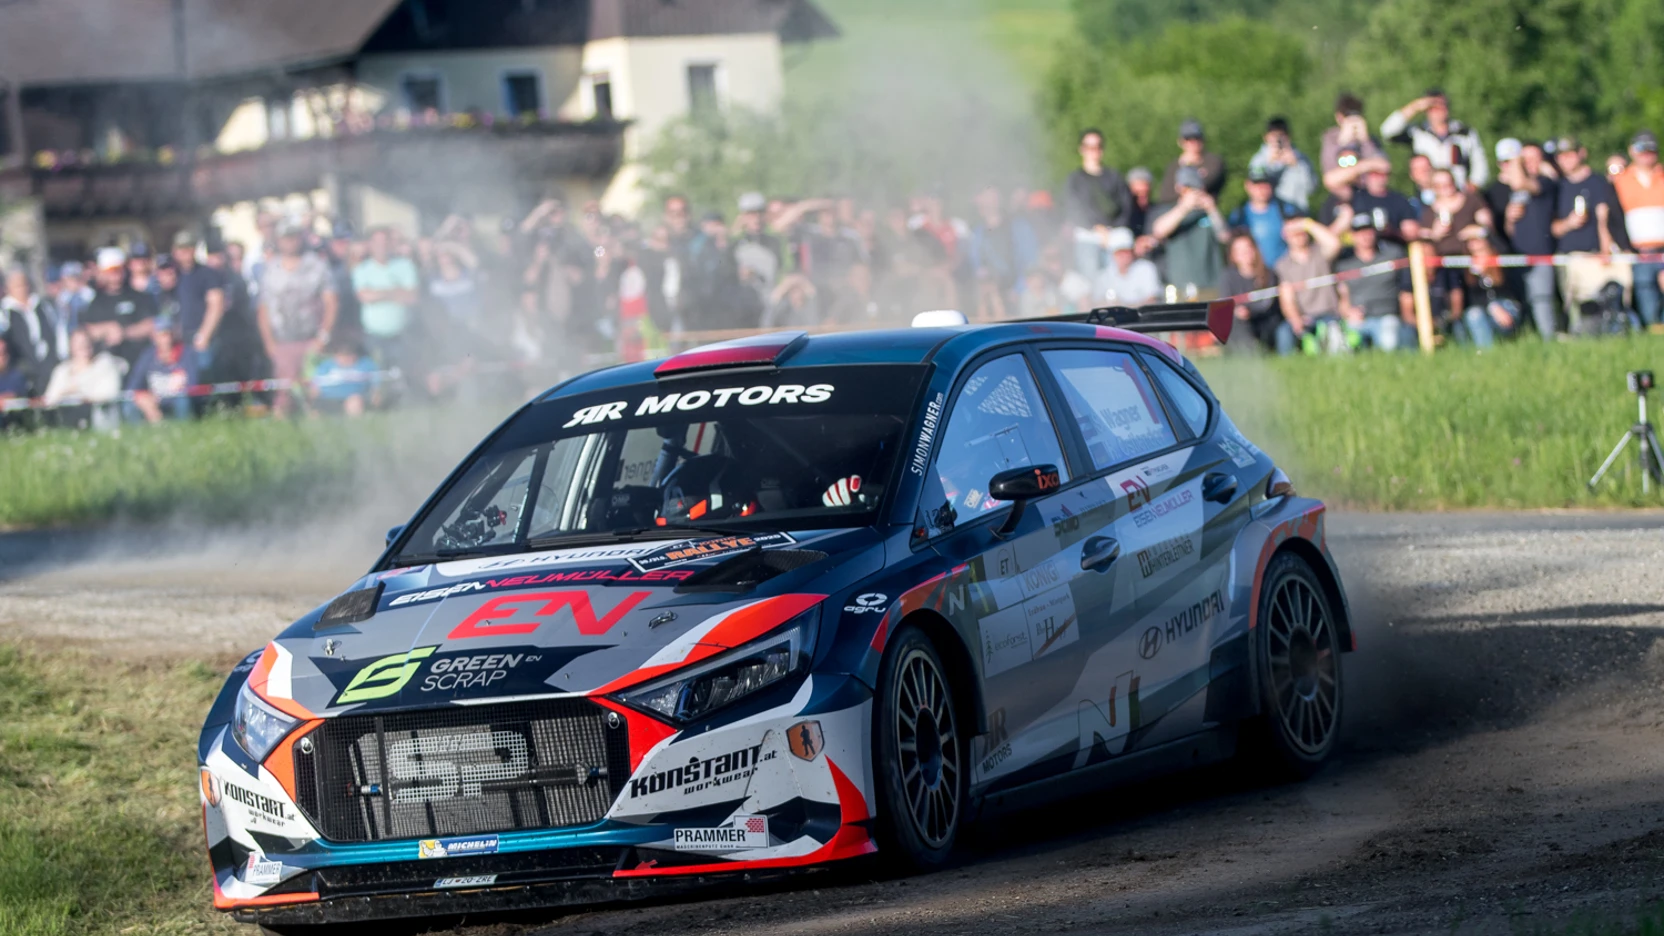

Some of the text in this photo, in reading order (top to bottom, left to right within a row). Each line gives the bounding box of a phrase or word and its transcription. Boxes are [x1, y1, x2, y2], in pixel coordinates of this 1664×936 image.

[635, 384, 835, 416] MOTORS
[665, 537, 756, 560] RALLYE
[843, 605, 887, 615] agru
[1165, 588, 1225, 645] HYUNDAI
[430, 653, 524, 673] GREEN
[420, 670, 507, 692] SCRAP
[982, 743, 1013, 774] MOTORS
[683, 767, 758, 796] workwear
[447, 839, 498, 851] MICHELIN
[675, 829, 747, 843] PRAMMER
[252, 862, 281, 877] PRAMMER
